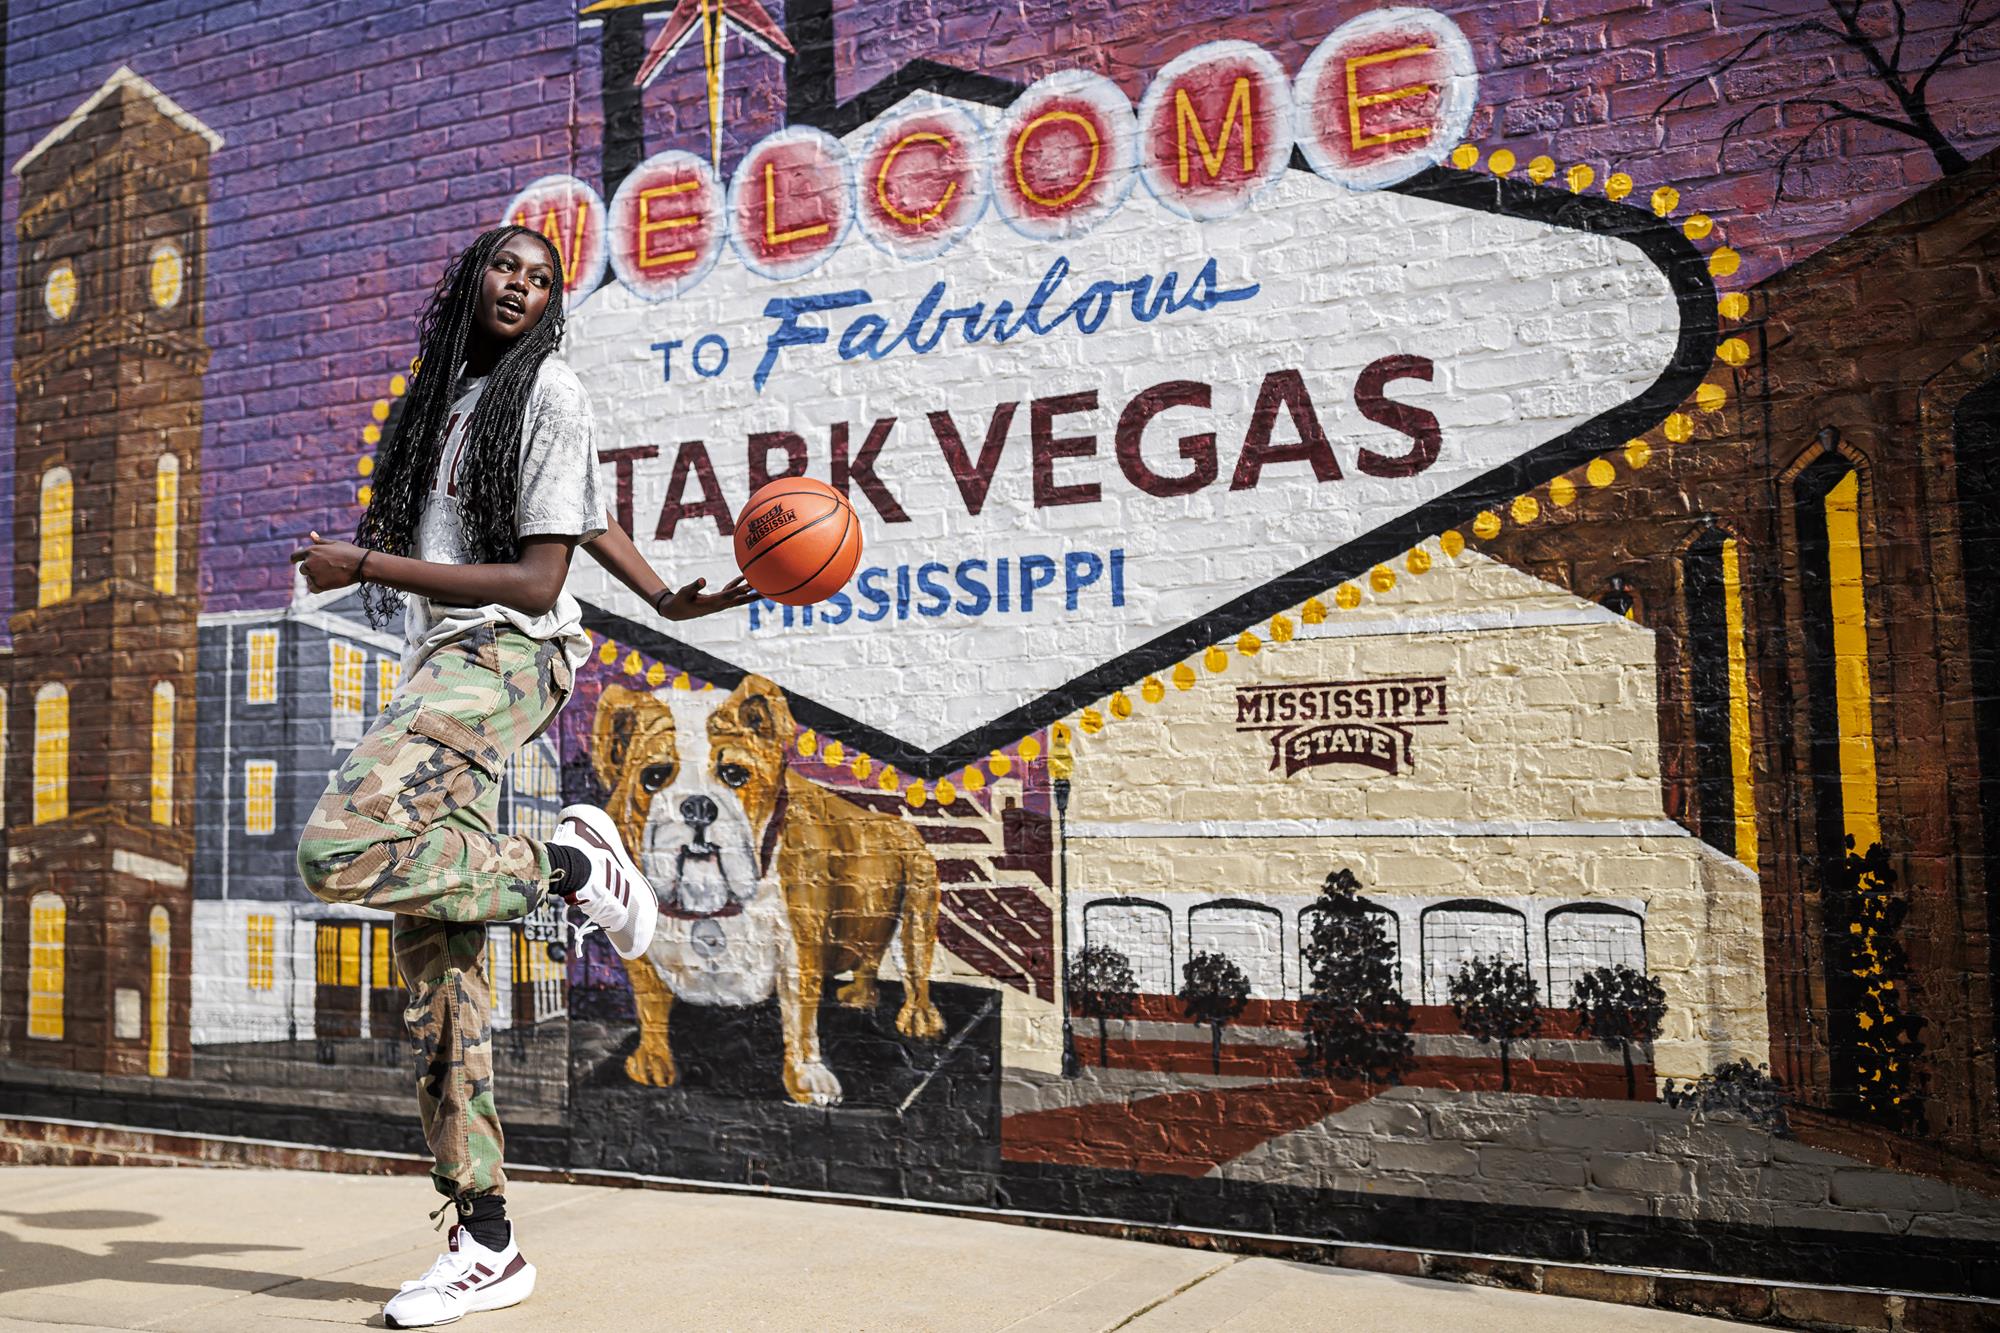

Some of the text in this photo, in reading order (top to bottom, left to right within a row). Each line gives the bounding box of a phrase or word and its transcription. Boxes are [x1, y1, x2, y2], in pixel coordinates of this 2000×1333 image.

[516, 45, 1433, 284] WELCOME
[650, 256, 1260, 393] TO Fabulous
[927, 354, 1442, 515] VEGAS
[1236, 685, 1448, 722] MISSISSIPPI
[1293, 729, 1391, 760] STATE
